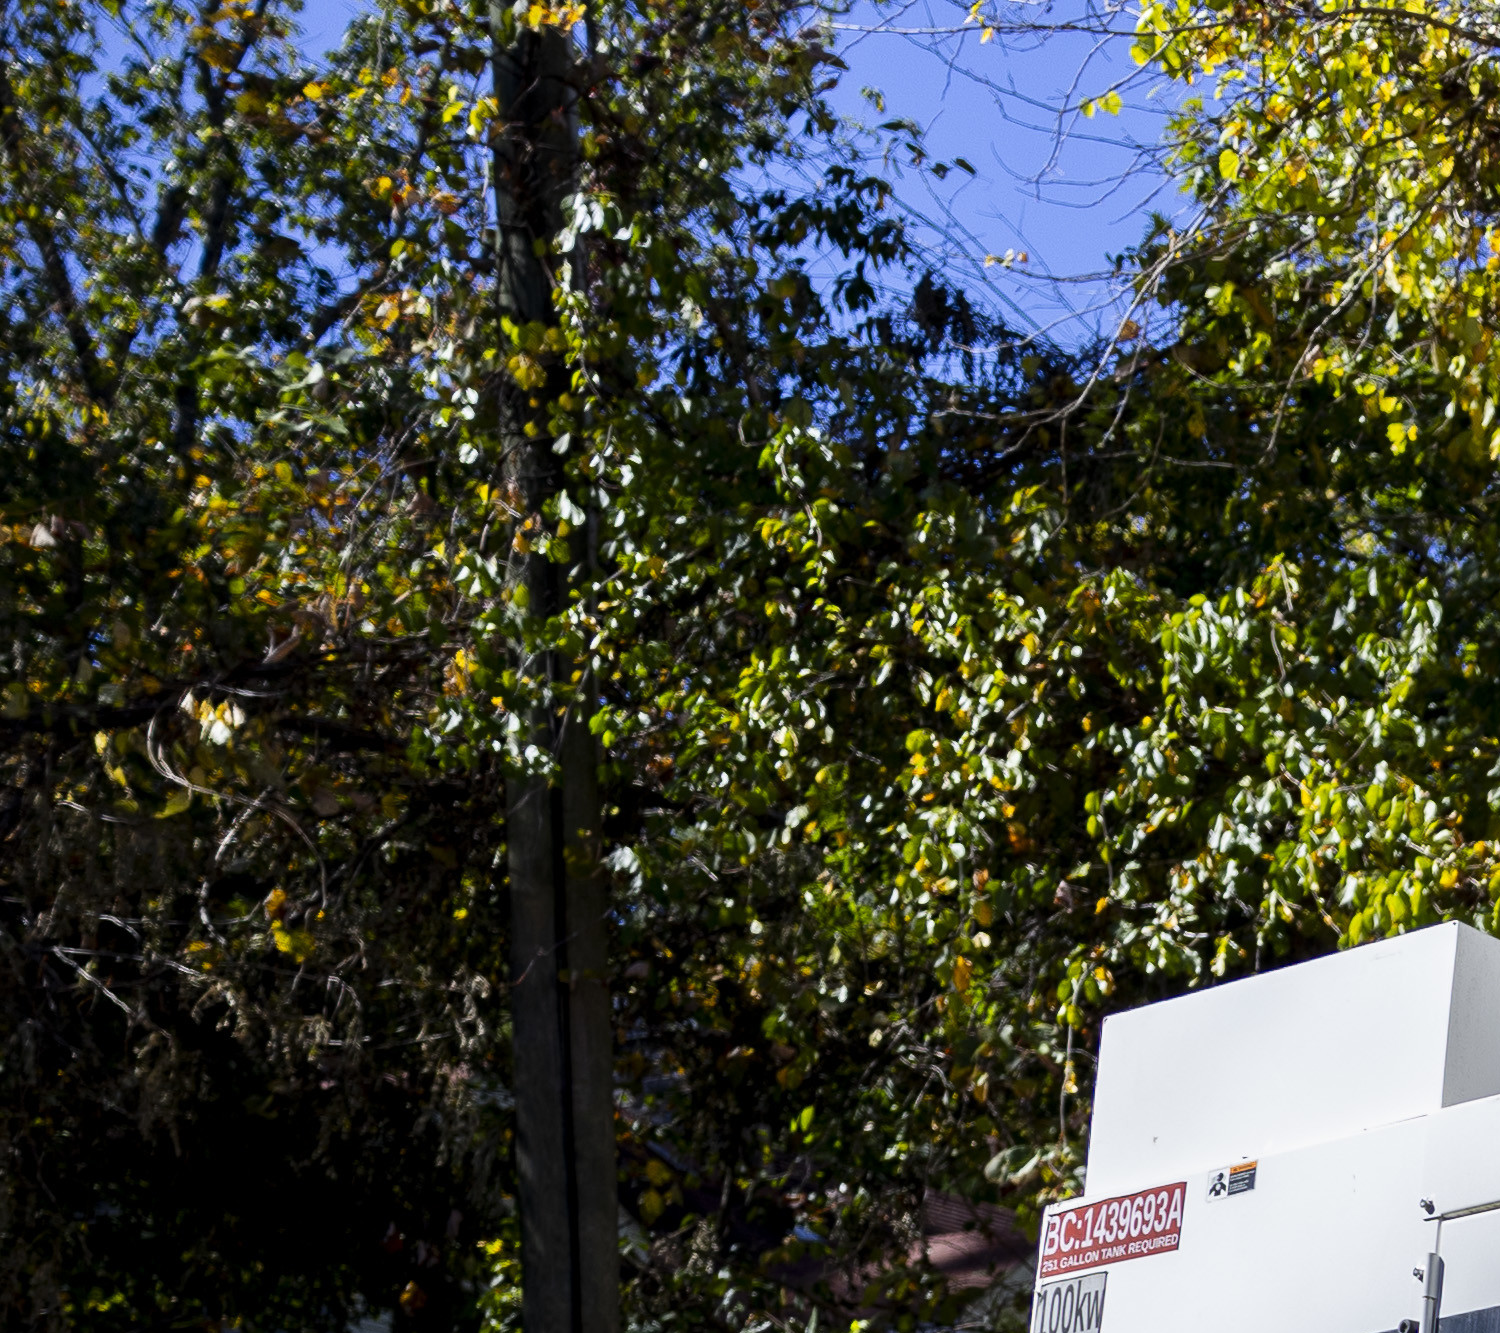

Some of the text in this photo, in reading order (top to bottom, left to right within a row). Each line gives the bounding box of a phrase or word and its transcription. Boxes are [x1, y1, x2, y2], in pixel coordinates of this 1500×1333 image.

[1044, 1188, 1181, 1256] BC:1439693A
[1042, 1233, 1179, 1273] 251 GALLON TANK REQUIRED
